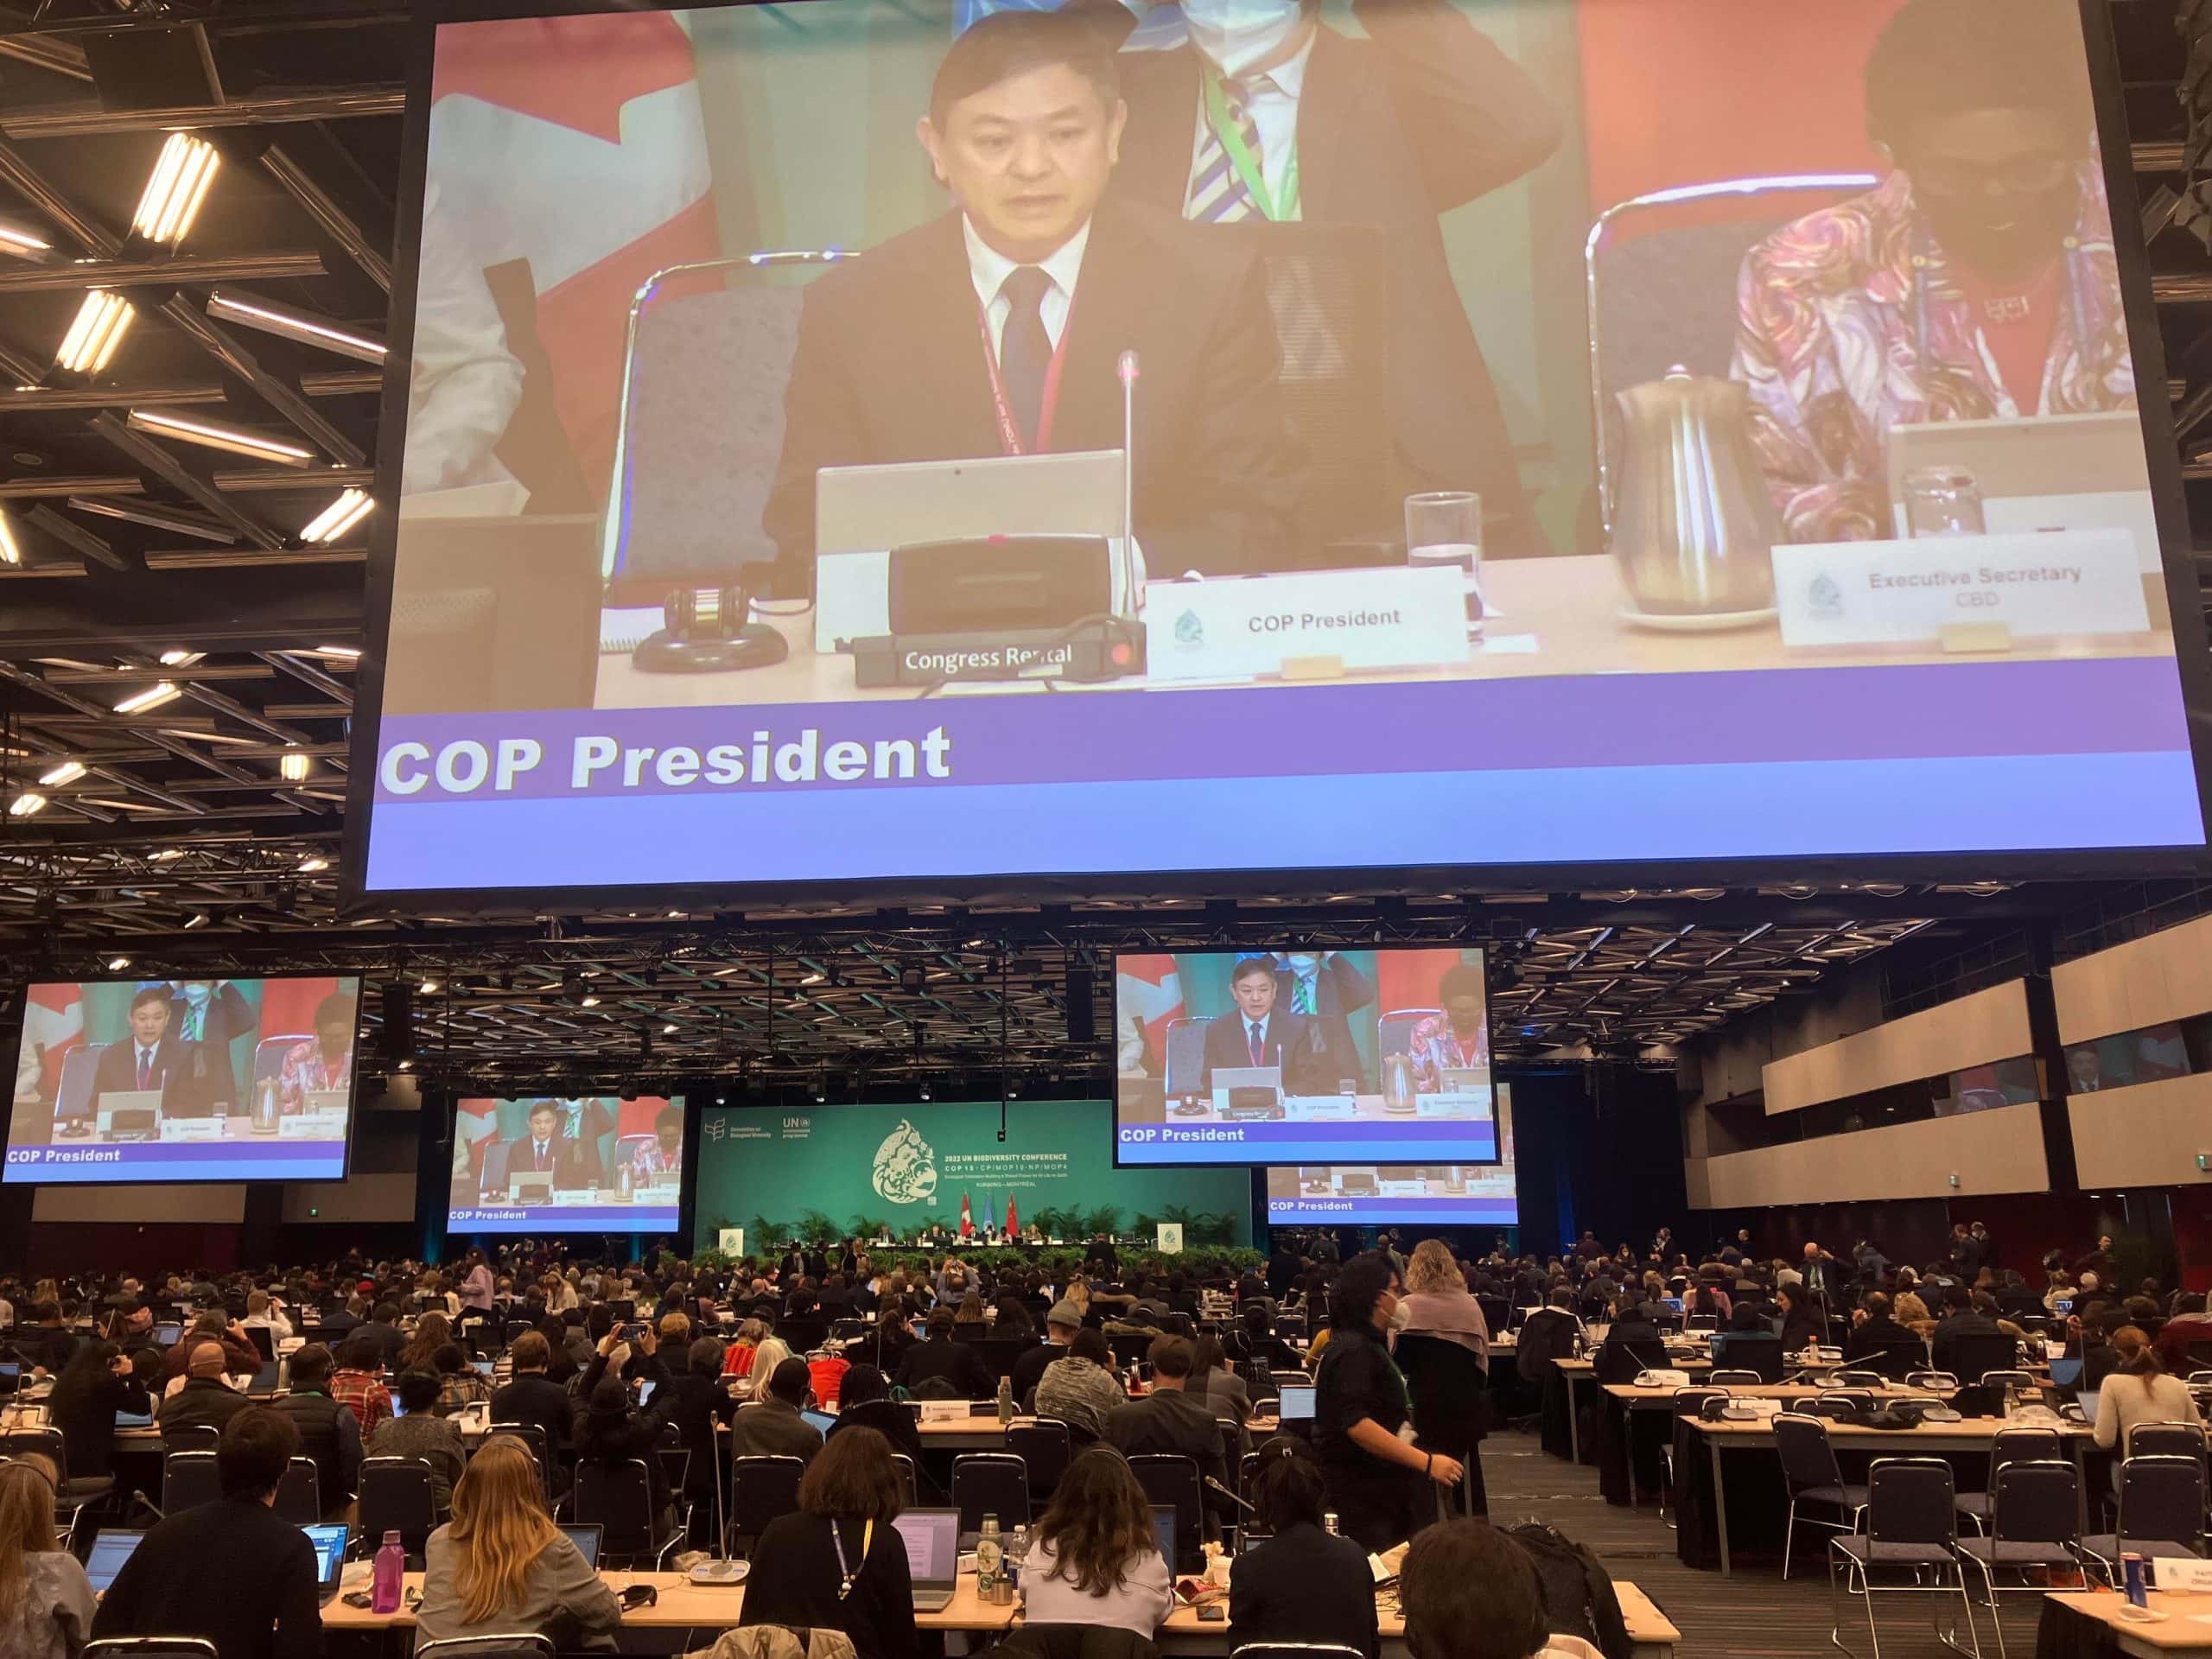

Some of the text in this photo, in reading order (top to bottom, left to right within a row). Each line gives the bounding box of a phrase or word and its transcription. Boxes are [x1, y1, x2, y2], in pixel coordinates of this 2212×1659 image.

[1869, 566, 2082, 589] Executive Secretary
[1955, 592, 2000, 607] CBD
[1249, 609, 1401, 633] COP President
[906, 651, 1001, 674] Congress
[380, 726, 952, 795] COP President
[783, 1118, 799, 1128] UN
[1121, 1124, 1244, 1141] COP President
[8, 1148, 121, 1163] COP President
[1270, 1201, 1354, 1211] COP President
[449, 1211, 526, 1220] COP President
